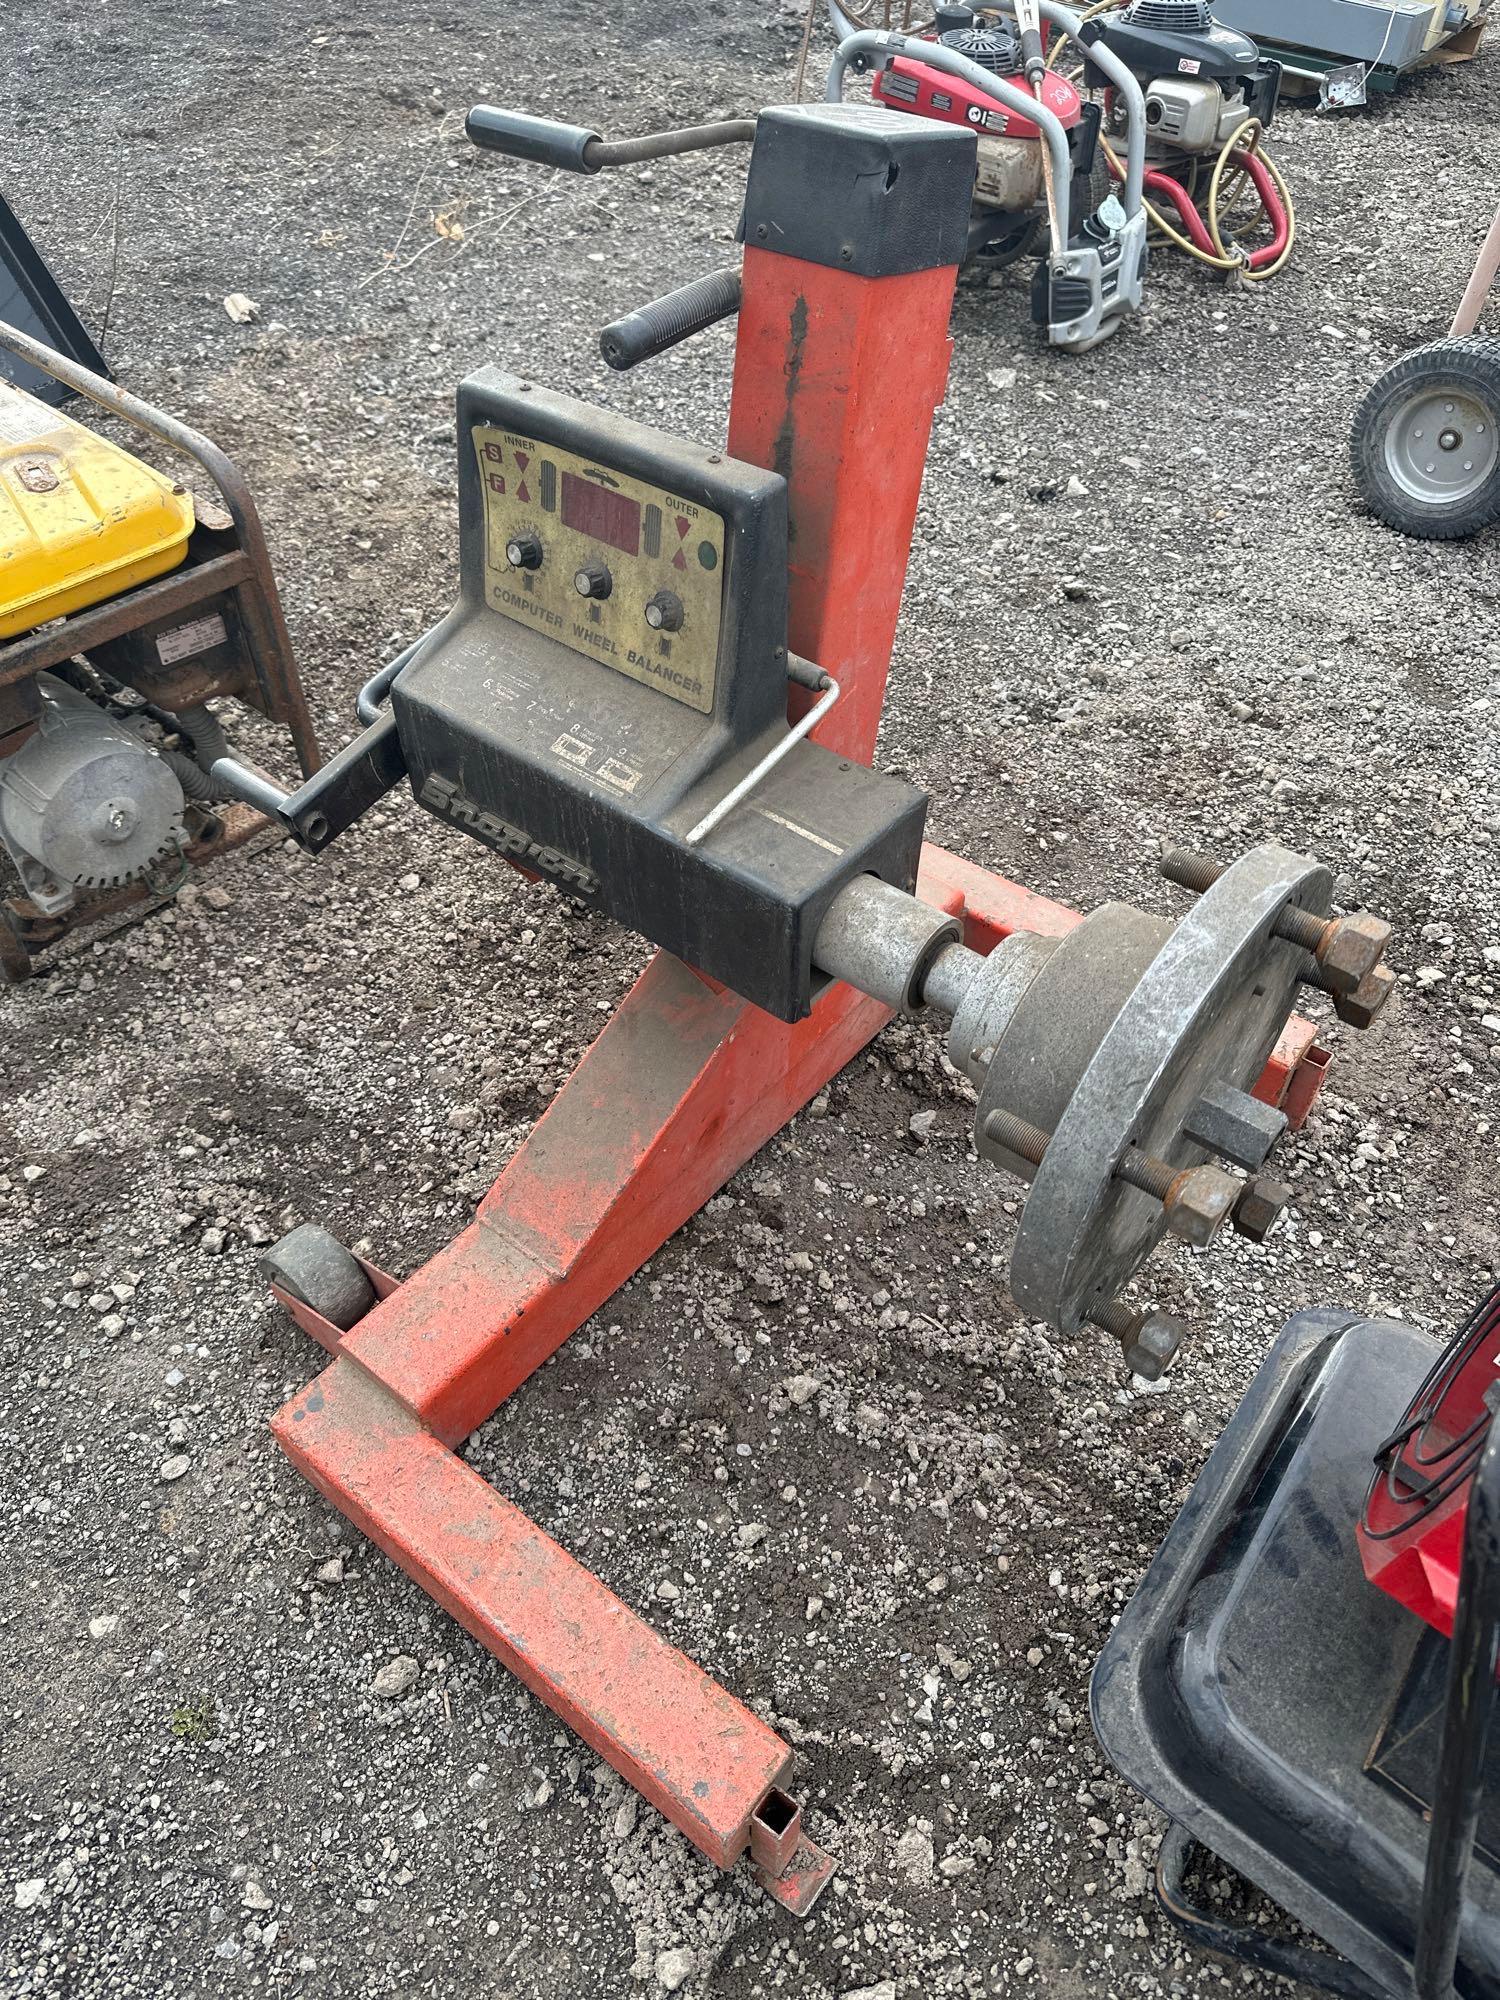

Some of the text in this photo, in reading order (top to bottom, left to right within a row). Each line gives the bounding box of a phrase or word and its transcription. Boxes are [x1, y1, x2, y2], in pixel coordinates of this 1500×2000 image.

[504, 434, 536, 452] INNER
[489, 445, 500, 461] S
[493, 475, 504, 490] F
[665, 496, 699, 519] OUTER
[493, 586, 564, 628] COMPUTER
[572, 622, 618, 655] WHEEL
[626, 650, 703, 696] BALANCER
